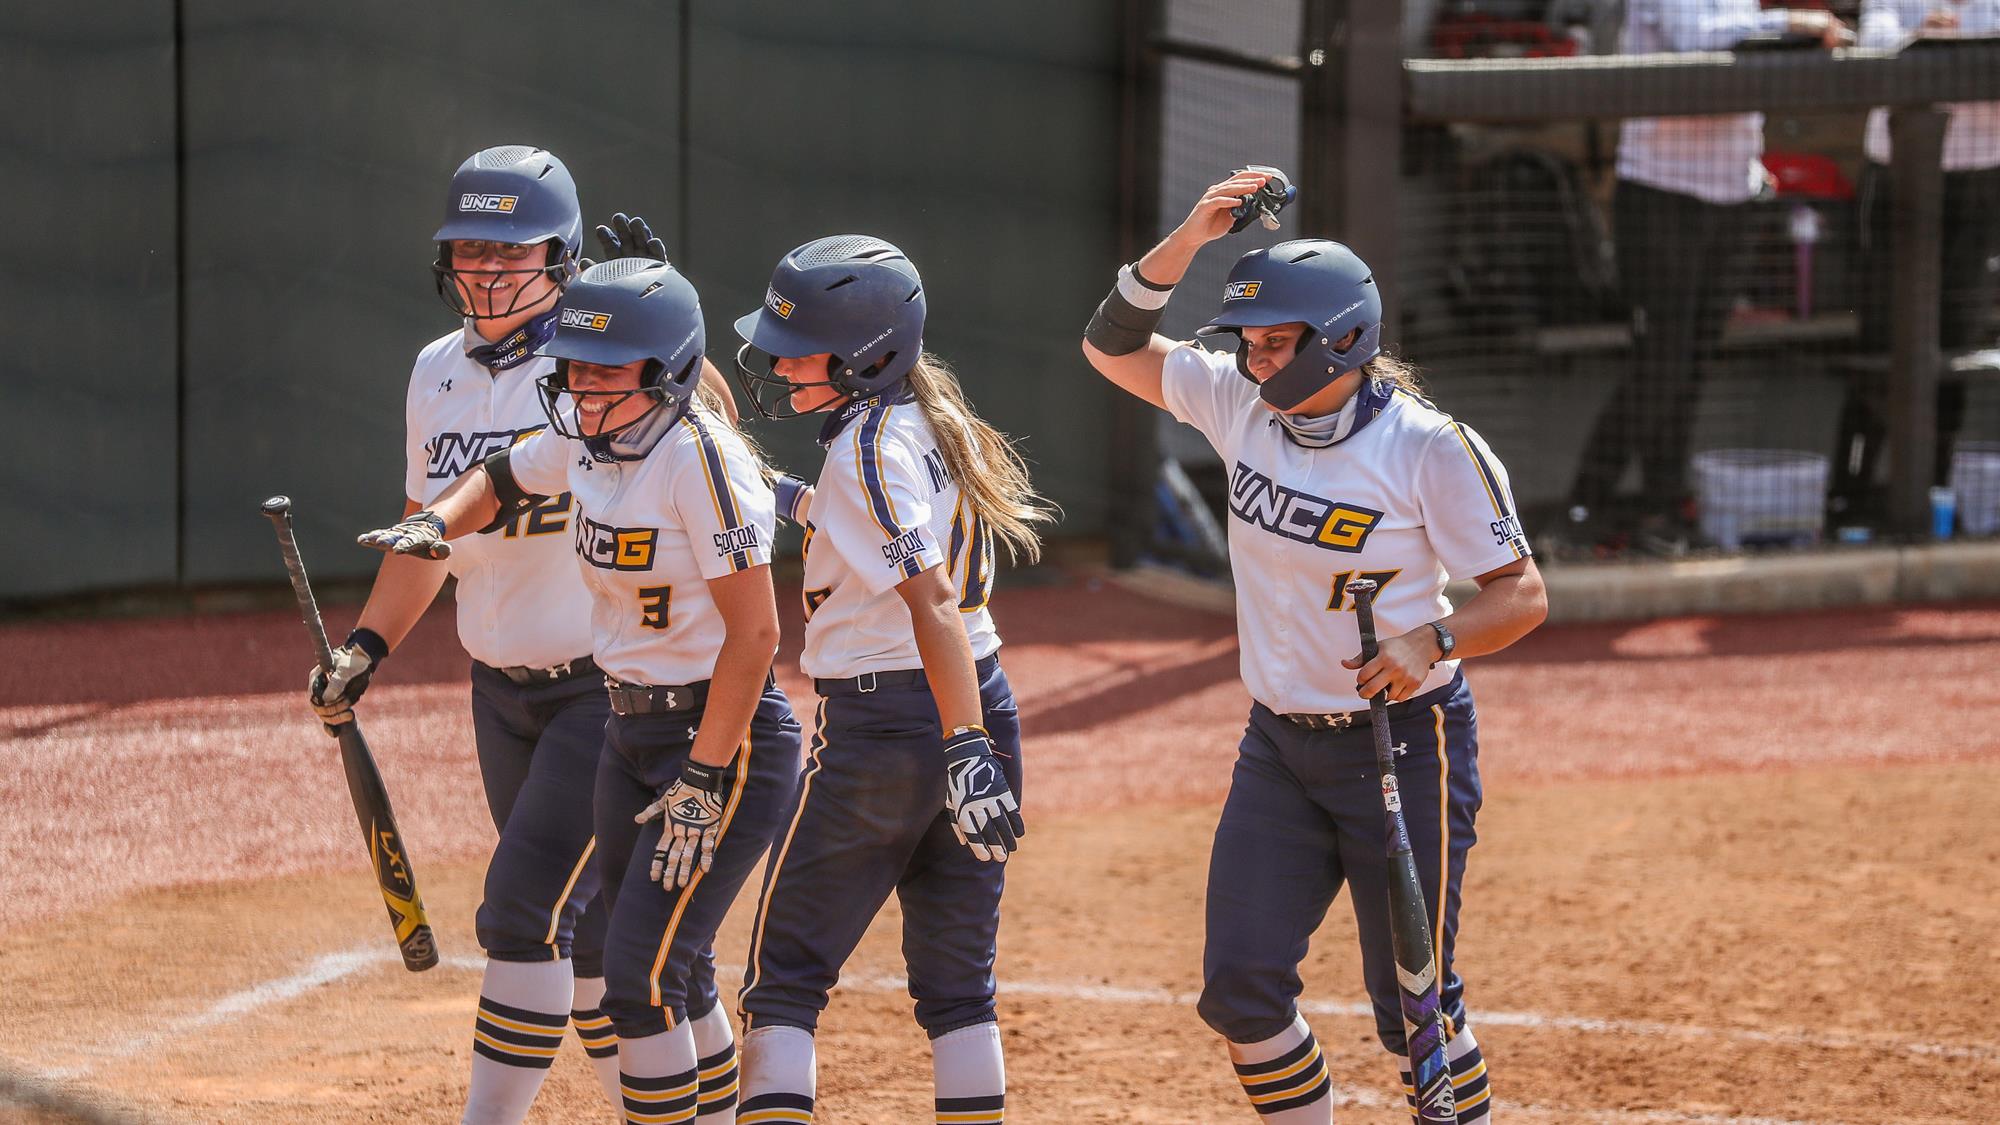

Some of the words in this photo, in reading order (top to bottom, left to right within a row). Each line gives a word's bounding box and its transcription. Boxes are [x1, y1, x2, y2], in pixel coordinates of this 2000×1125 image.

[459, 194, 519, 214] UNCG
[560, 309, 612, 332] UNCG
[852, 328, 893, 358] EVOSHIELD
[424, 423, 550, 479] UNC
[1229, 460, 1385, 553] UNCG
[575, 500, 659, 572] NCG
[713, 524, 758, 557] SOCON
[882, 527, 926, 569] SOCON
[638, 584, 672, 632] 3
[1326, 568, 1403, 612] 17
[1396, 811, 1408, 846] OUISVILLE
[379, 831, 410, 886] LXT
